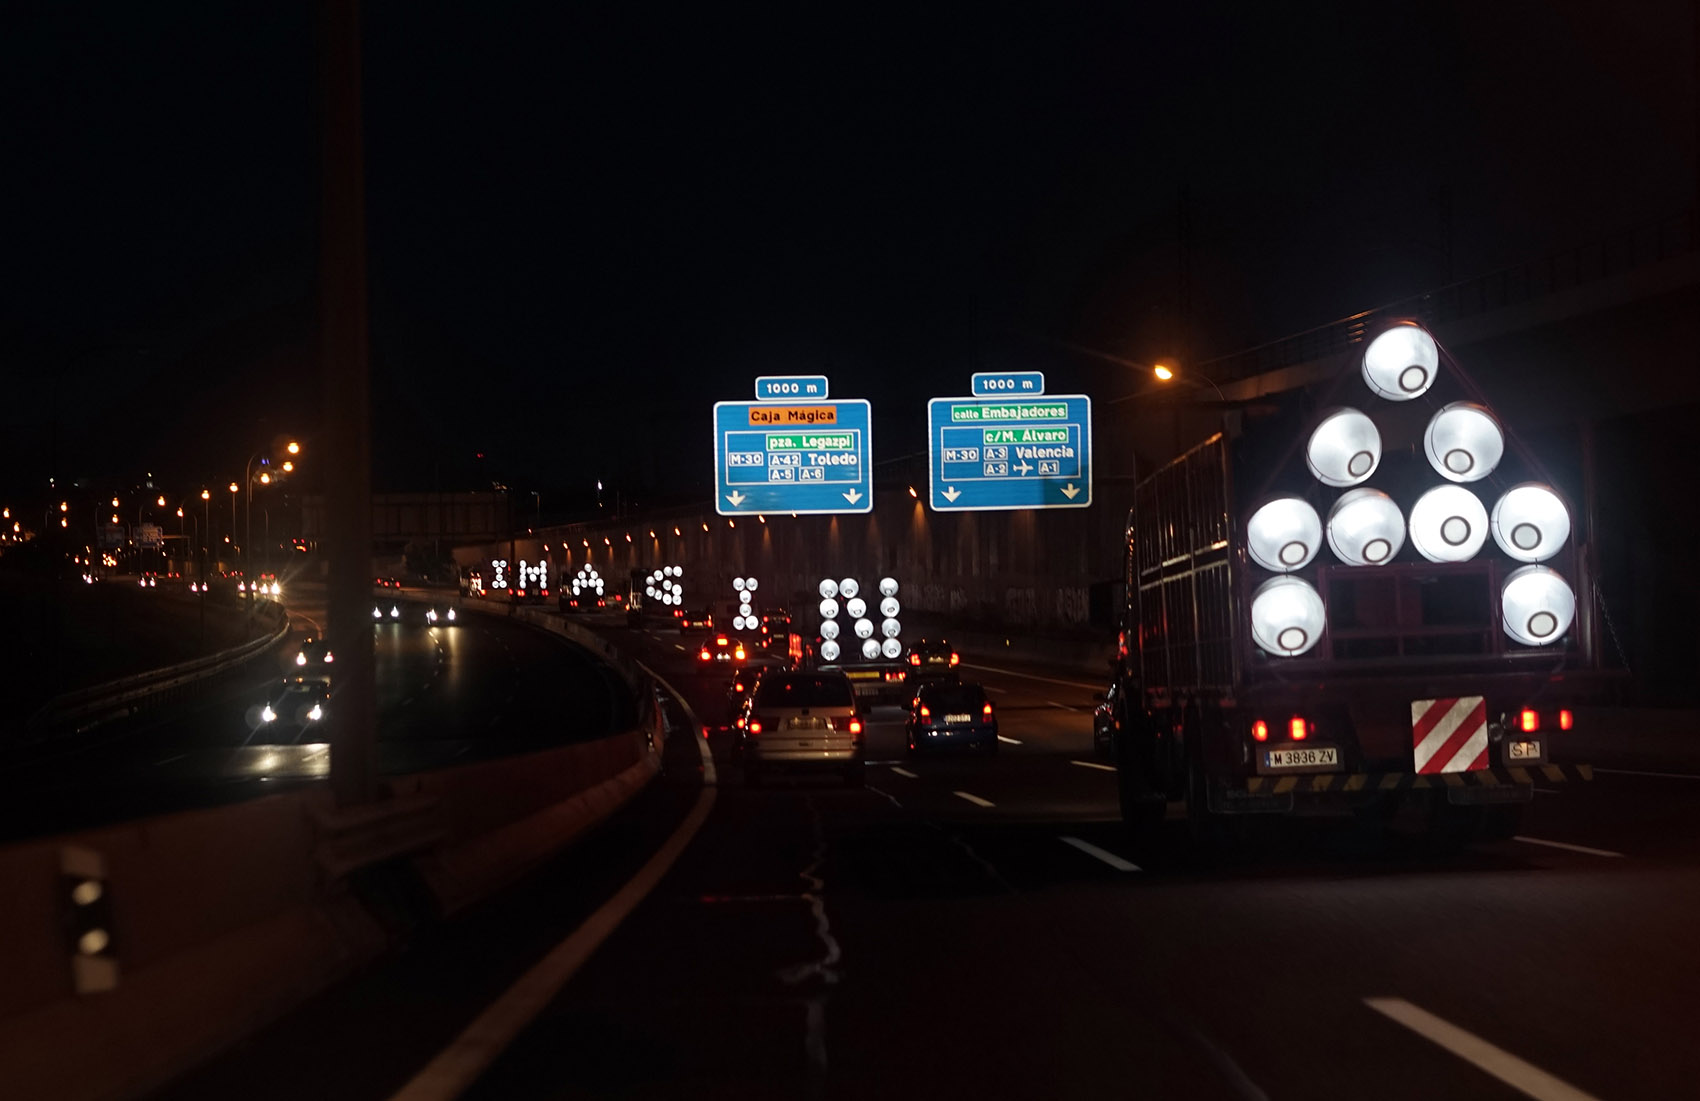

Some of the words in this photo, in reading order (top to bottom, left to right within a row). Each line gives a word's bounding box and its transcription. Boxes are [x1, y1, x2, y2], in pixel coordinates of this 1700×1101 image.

[766, 383, 799, 394] 1000
[807, 384, 818, 393] m
[983, 379, 1015, 390] 1000
[1022, 380, 1033, 389] m
[751, 410, 781, 423] Caja
[788, 408, 835, 424] Mágica
[954, 409, 979, 419] calle
[982, 406, 1066, 420] Embajadores
[1022, 428, 1067, 441] Álvaro
[769, 437, 797, 450] pza.
[802, 435, 850, 449] Legazpi
[730, 453, 762, 465] M-30
[771, 454, 800, 466] A-42
[808, 453, 858, 466] Toledo
[945, 450, 977, 461] M-30
[1016, 445, 1074, 459] Valencia
[1274, 753, 1282, 765] M
[1285, 751, 1316, 764] 3836
[1319, 750, 1334, 763] ZV
